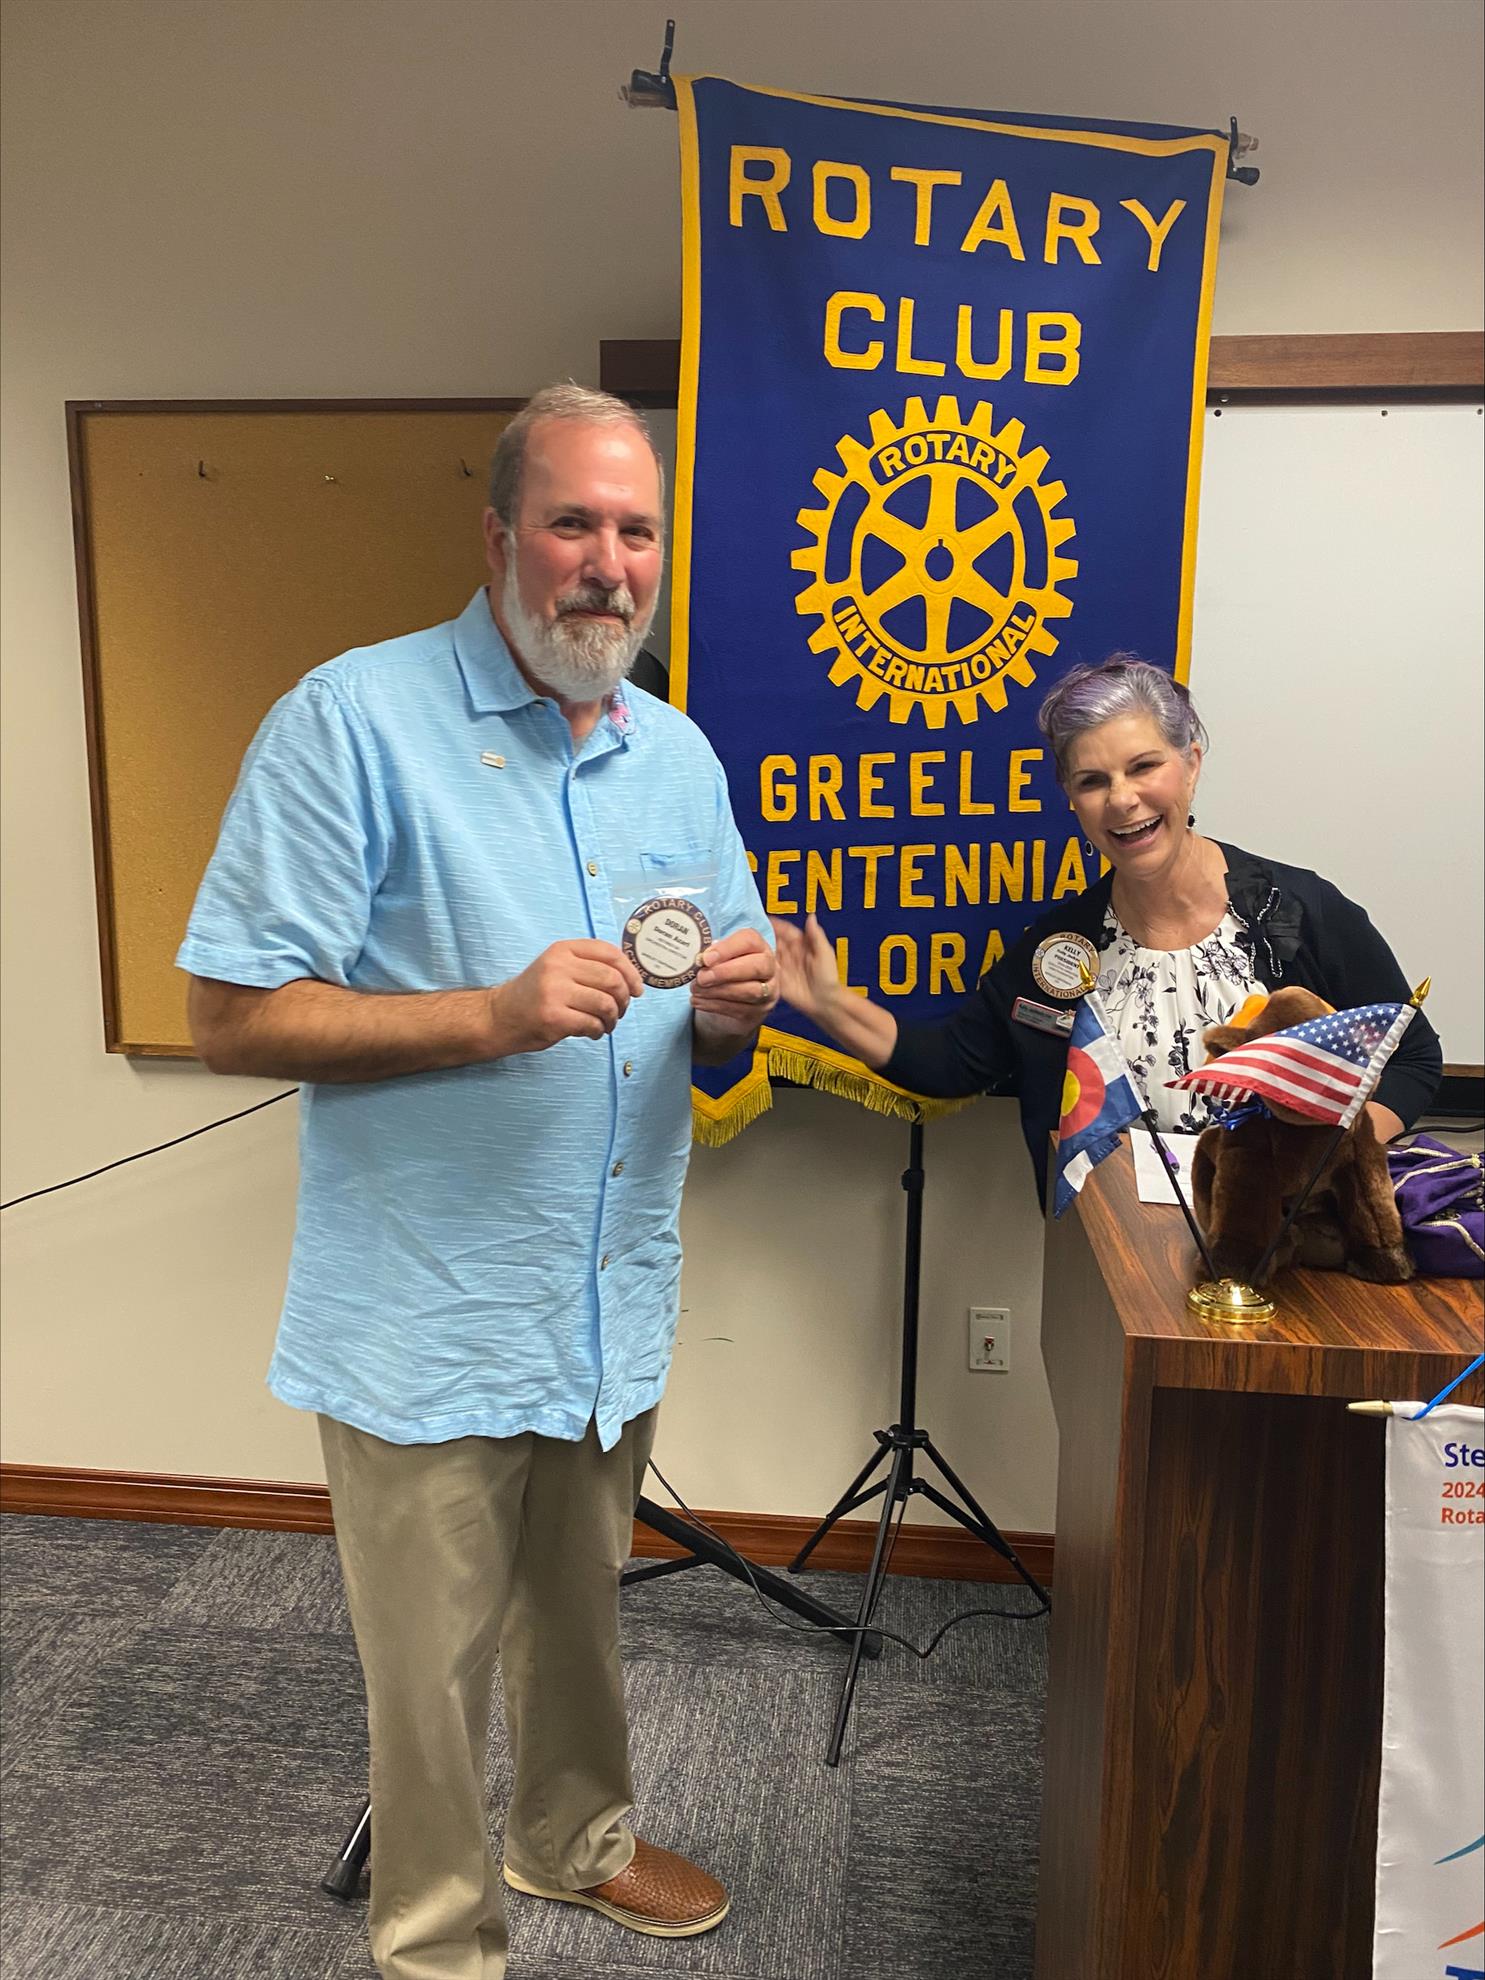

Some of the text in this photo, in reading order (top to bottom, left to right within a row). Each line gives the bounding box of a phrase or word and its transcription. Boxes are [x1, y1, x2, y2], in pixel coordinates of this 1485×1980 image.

[730, 145, 1186, 272] ROTARY
[824, 291, 1082, 386] CLUB
[878, 432, 1018, 486] ROTARY
[831, 603, 1037, 693] INTERNATIONAL
[759, 748, 1076, 822] GREELE
[746, 837, 1112, 914] ENTENNIA
[694, 911, 712, 945] CLUB
[1060, 933, 1096, 952] ROTARY
[1063, 945, 1082, 957] KELLY
[648, 970, 696, 987] MEMBER
[1033, 962, 1087, 998] INTERNATIONAL
[1441, 1481, 1484, 1499] 2024
[1441, 1507, 1484, 1524] Rota
